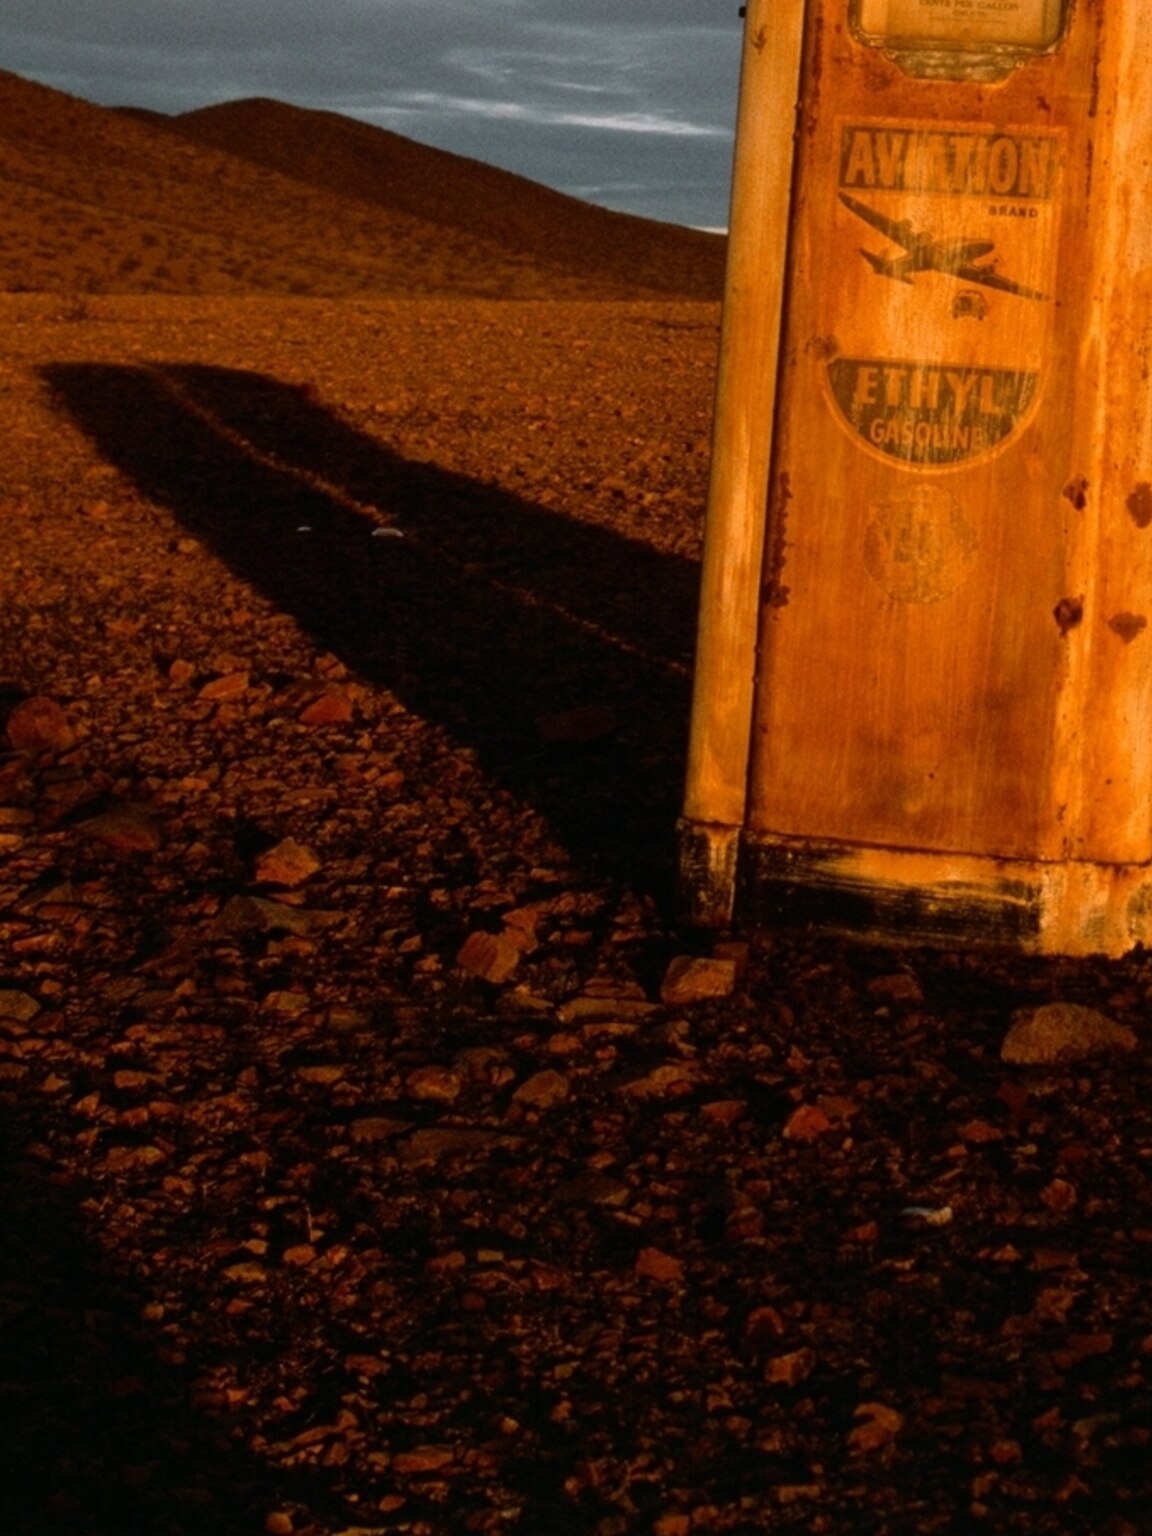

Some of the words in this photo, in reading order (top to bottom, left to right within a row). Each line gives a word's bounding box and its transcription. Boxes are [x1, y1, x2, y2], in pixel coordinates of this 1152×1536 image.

[988, 205, 1038, 219] BRAND
[855, 367, 1003, 417] ETHYL
[870, 418, 987, 450] GASOLINE
